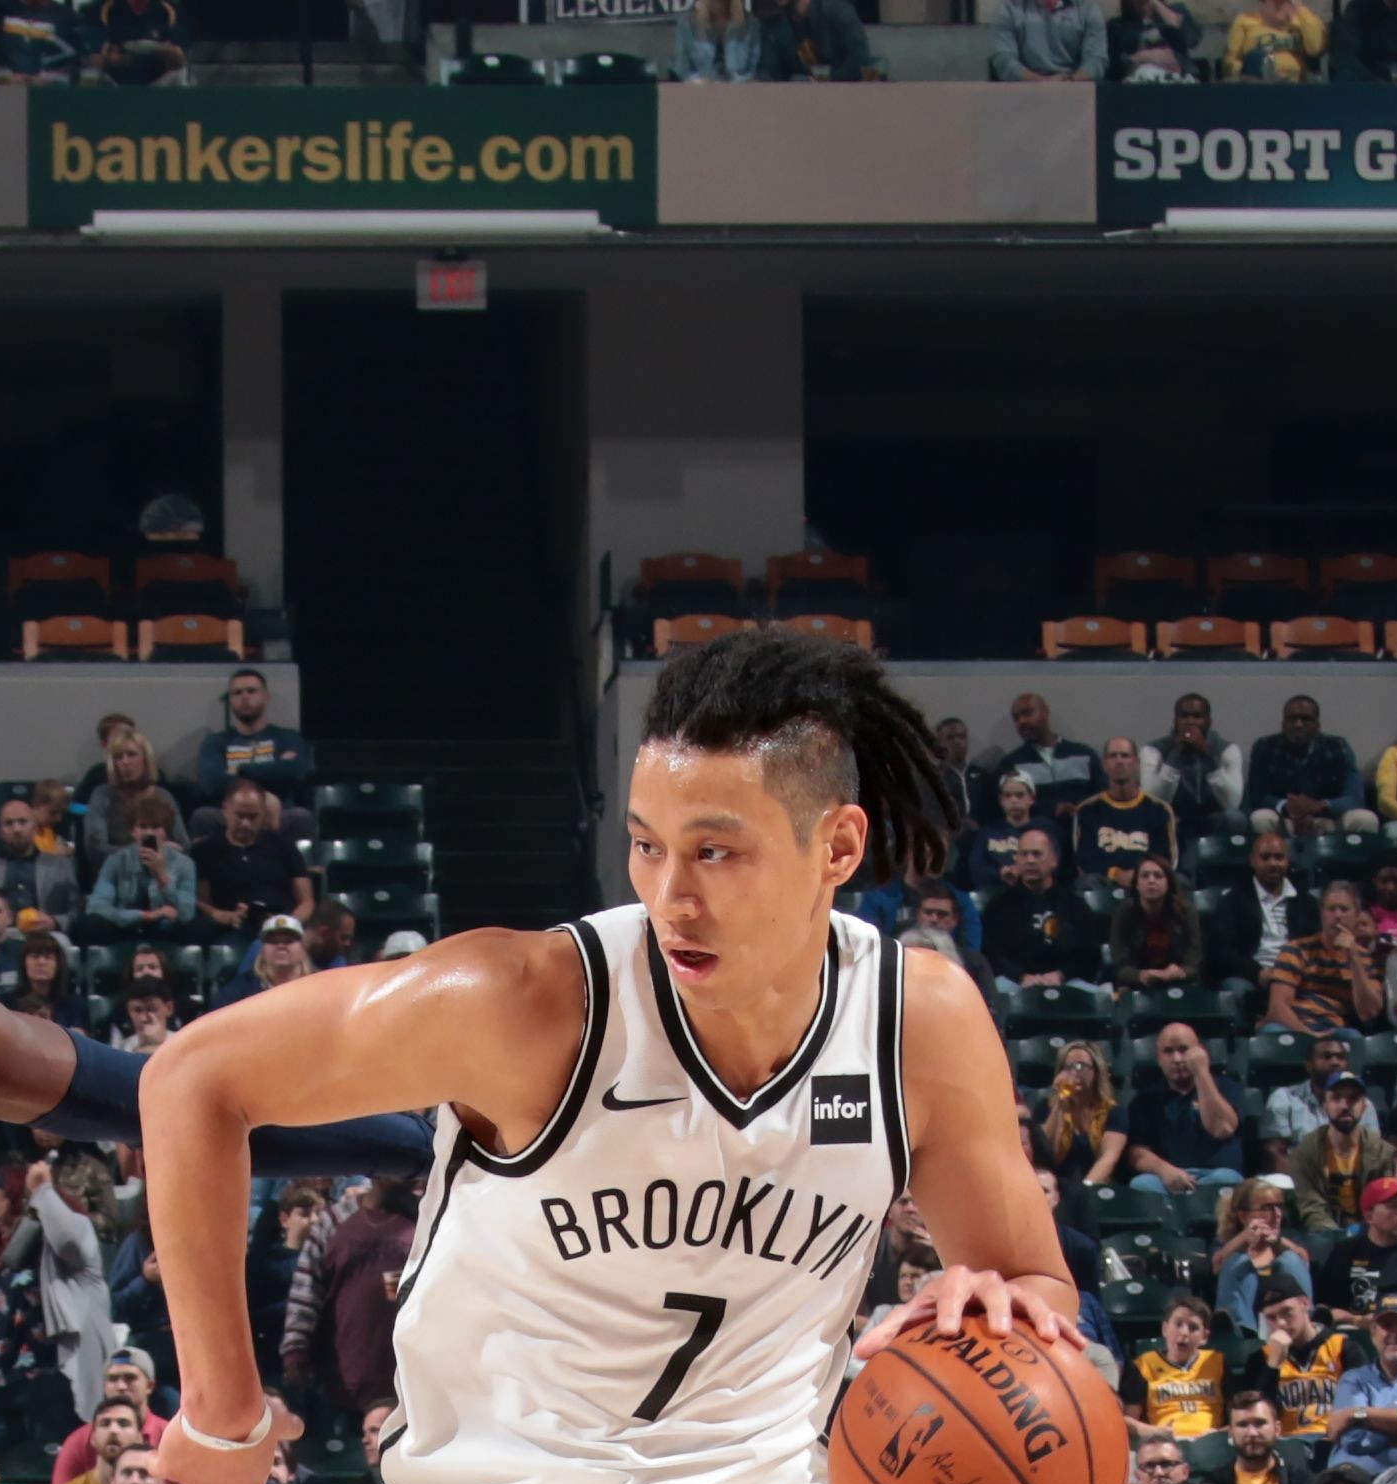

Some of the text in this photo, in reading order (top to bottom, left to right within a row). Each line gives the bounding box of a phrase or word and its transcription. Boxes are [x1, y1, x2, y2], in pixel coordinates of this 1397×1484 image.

[52, 121, 635, 183] bankerslife.com
[1112, 127, 1342, 182] SPORT
[429, 268, 476, 303] EXIT
[813, 1094, 868, 1120] infor
[540, 1175, 874, 1281] BROOKLYN
[632, 1291, 727, 1423] 7
[1276, 1379, 1334, 1409] NDIAN
